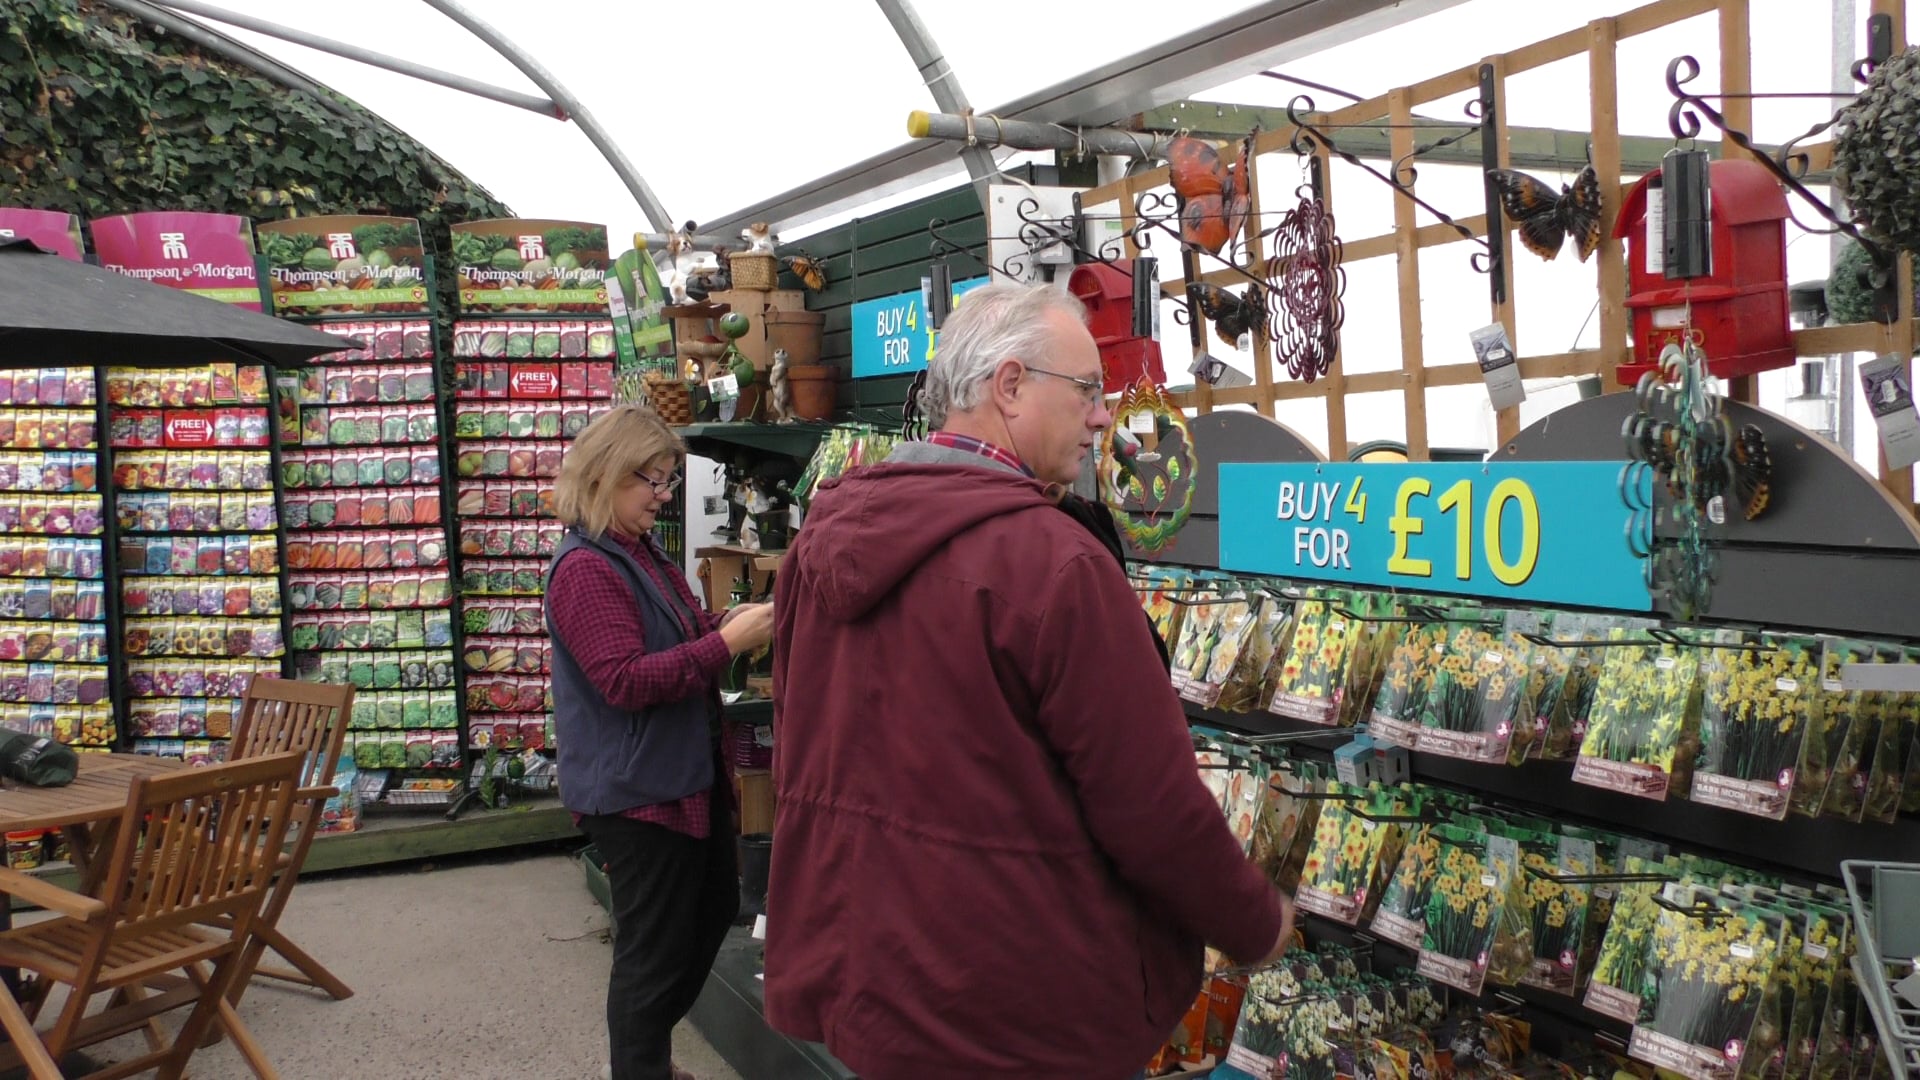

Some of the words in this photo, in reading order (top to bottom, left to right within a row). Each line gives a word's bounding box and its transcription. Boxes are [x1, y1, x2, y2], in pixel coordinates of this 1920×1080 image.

[105, 264, 182, 281] Thompson
[193, 263, 255, 279] Morgan
[271, 267, 349, 284] Thompson
[360, 265, 423, 280] Morgan
[459, 266, 535, 282] Thompson
[547, 266, 606, 282] Morgan
[877, 306, 905, 337] BUY
[906, 300, 917, 332] 4
[884, 337, 910, 366] FOR
[519, 372, 550, 381] FREE!
[174, 419, 205, 429] FREE!
[1277, 482, 1340, 521] BUY
[1343, 476, 1367, 523] 4
[1293, 526, 1351, 570] FOR
[1387, 477, 1540, 585] £10
[1635, 1038, 1657, 1052] BABY
[1660, 1046, 1687, 1064] MOON
